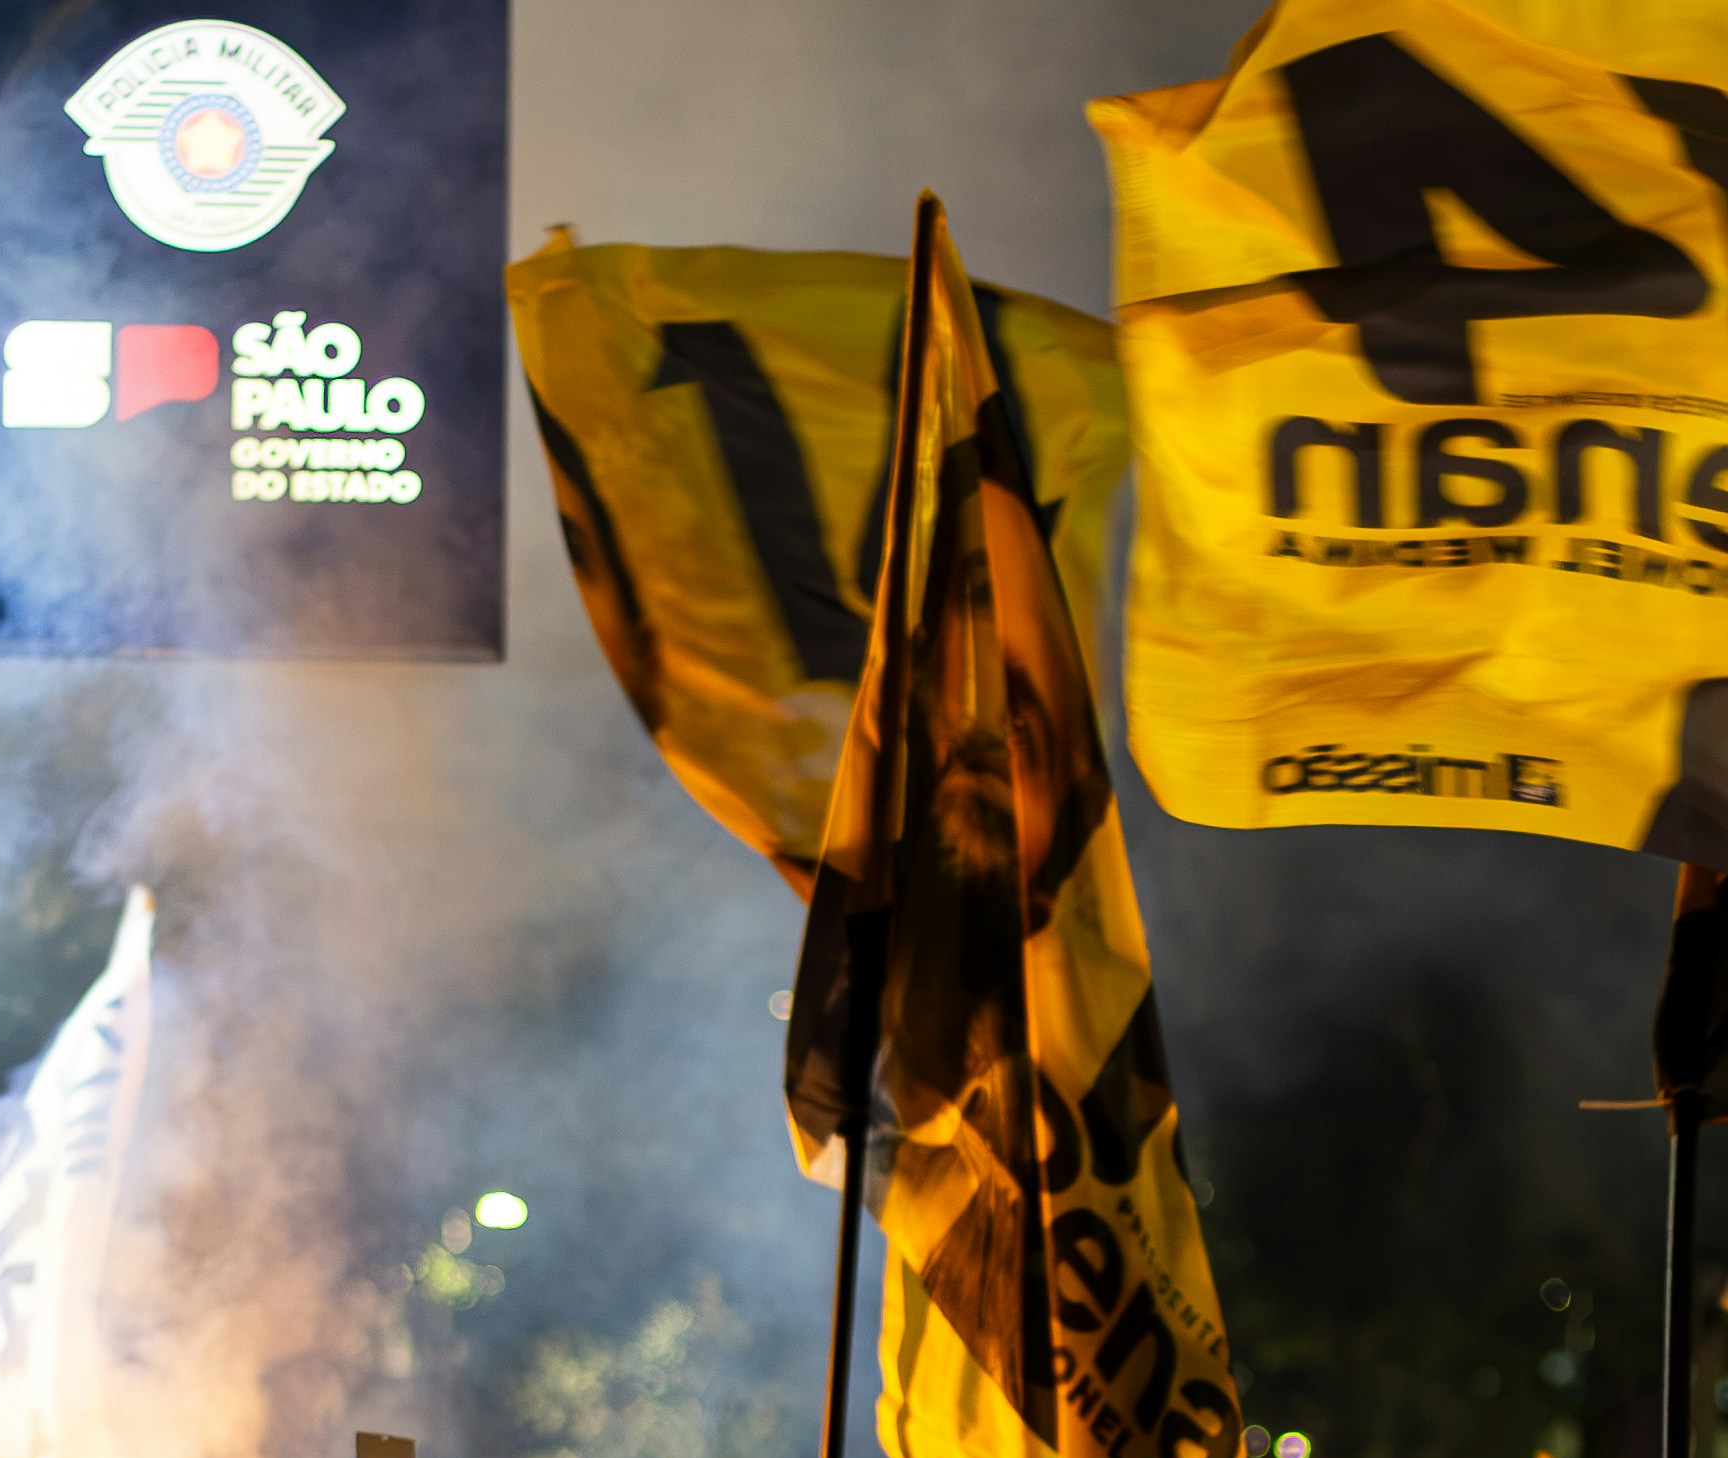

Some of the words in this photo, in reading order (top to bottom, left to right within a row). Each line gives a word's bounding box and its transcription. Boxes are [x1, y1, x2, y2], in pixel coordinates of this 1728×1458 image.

[218, 38, 318, 118] MILITAR
[231, 310, 362, 378] SÃO
[231, 377, 426, 434] PAULO
[230, 436, 406, 471] GOVERNO
[231, 470, 288, 502] DO
[290, 470, 423, 504] ESTADO
